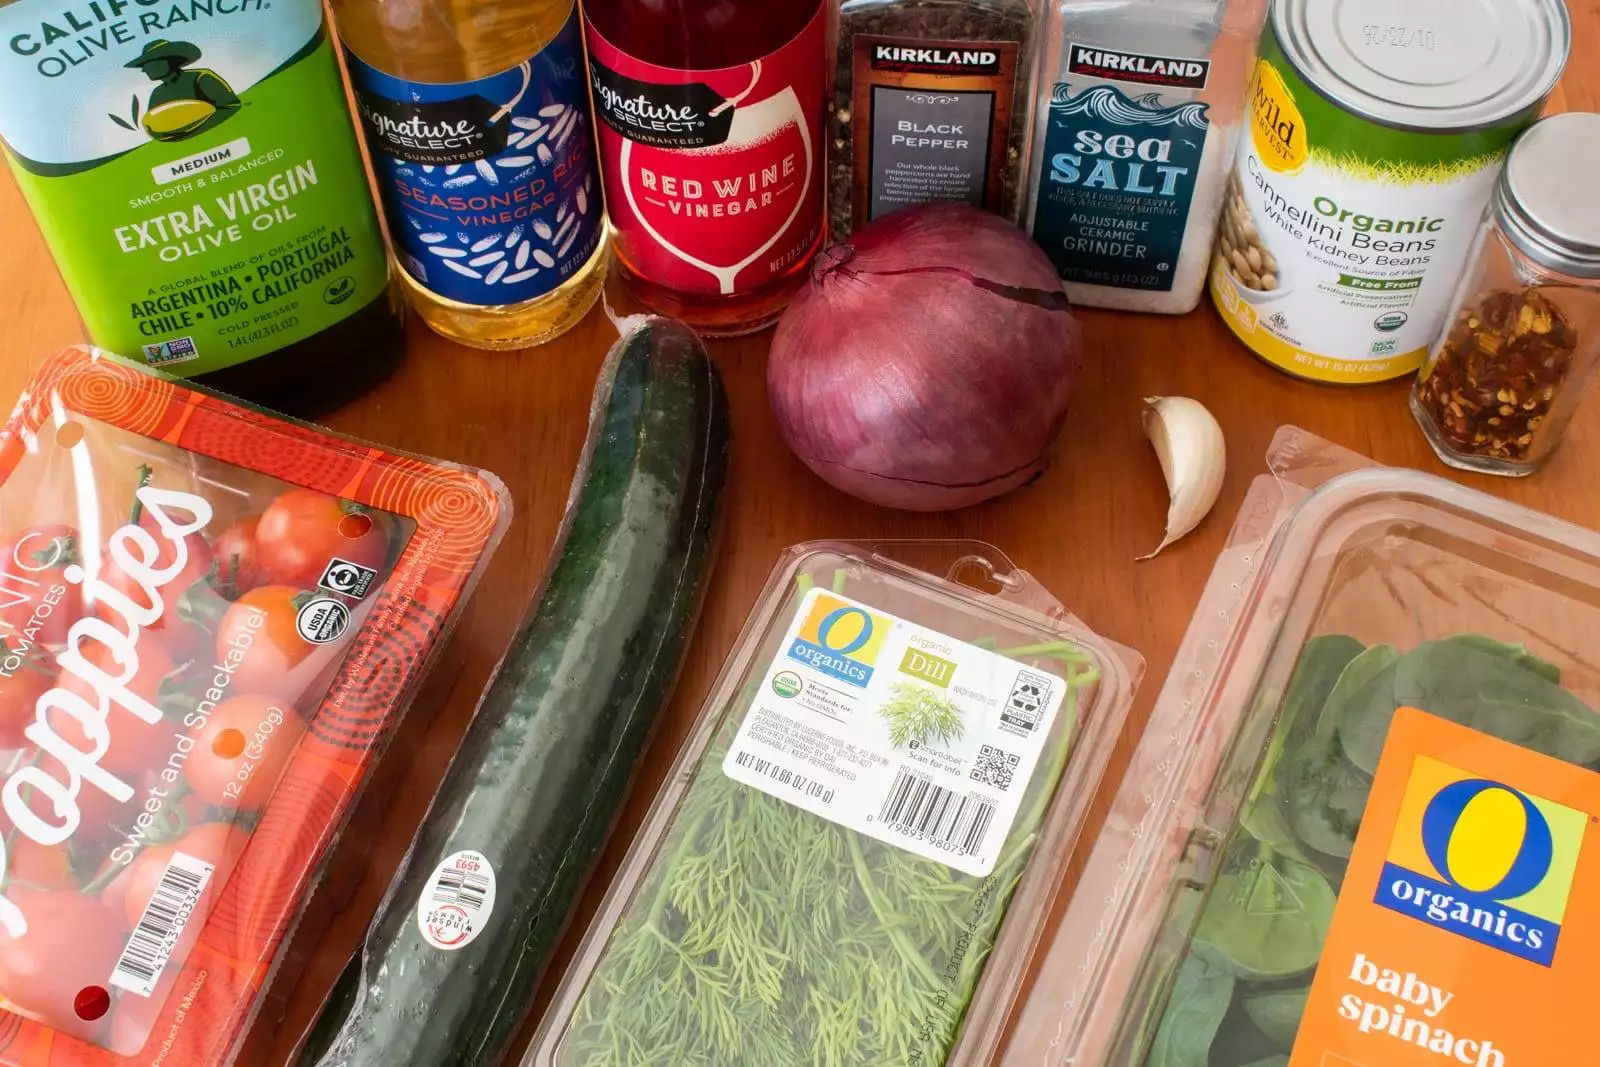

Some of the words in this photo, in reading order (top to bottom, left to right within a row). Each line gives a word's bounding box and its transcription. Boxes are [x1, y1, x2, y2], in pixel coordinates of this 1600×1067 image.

[10, 0, 159, 56] CALIF
[37, 21, 136, 77] OLIVE
[138, 0, 263, 35] RANCH
[876, 46, 997, 65] KIRKLAND
[1077, 48, 1203, 78] KIRKLAND
[590, 62, 698, 120] Signature
[613, 107, 697, 132] SELECT
[897, 120, 964, 135] BLACK
[1256, 77, 1295, 149] wild
[387, 132, 474, 150] SELECT
[627, 130, 704, 145] GUARANTEED
[891, 134, 969, 149] PEPPER
[1074, 129, 1172, 163] sea
[171, 148, 232, 177] MEDIUM
[404, 149, 484, 163] GUARANTEED
[885, 168, 935, 177] peppercorns
[912, 163, 937, 171] whole
[129, 182, 193, 210] SMOOTH
[197, 178, 207, 189] &
[211, 148, 284, 184] BALANCED
[641, 167, 703, 199] RED
[712, 153, 795, 198] WINE
[1050, 152, 1188, 196] SALT
[113, 203, 215, 253] EXTRA
[215, 159, 318, 221] VIRGIN
[394, 178, 546, 212] SEASONED
[457, 193, 556, 226] VINEGAR
[668, 191, 772, 217] VINEGAR
[1247, 155, 1343, 242] Cannellini
[1351, 231, 1437, 253] Beans
[1069, 213, 1150, 232] ADJUSTABLE
[1312, 195, 1445, 234] Organic
[159, 224, 242, 262] OLIVE
[252, 205, 297, 231] OIL
[1063, 236, 1147, 259] GRINDER
[1079, 226, 1135, 242] CERAMIC
[1263, 200, 1304, 240] White
[1307, 235, 1370, 266] Kidney
[1374, 254, 1431, 267] Beans
[130, 275, 243, 319] ARGENTINA
[256, 226, 352, 282] PORTUGAL
[148, 288, 156, 296] A
[160, 273, 207, 293] GLOBAL
[210, 260, 245, 277] BLEND
[250, 253, 265, 265] OF
[268, 241, 293, 257] OILS
[296, 225, 326, 243] FROM
[1306, 250, 1349, 271] Excellent
[1352, 266, 1387, 277] Source
[1388, 269, 1399, 277] of
[1399, 267, 1427, 276] Fiber
[139, 312, 195, 337] CHILE
[206, 295, 248, 320] 10%
[251, 245, 355, 306] CALIFORNIA
[1317, 283, 1354, 298] Artificial
[1355, 292, 1413, 301] Preservatives
[1351, 278, 1382, 289] Free
[1385, 279, 1419, 289] From
[217, 320, 250, 336] COLD
[254, 301, 299, 325] PRESSED
[1340, 299, 1378, 308] Artificial
[1294, 352, 1313, 365] NET
[1314, 359, 1330, 370] WT
[0, 583, 66, 678] TOMATOES
[307, 608, 328, 632] USDA
[319, 607, 341, 638] ORGANIC
[373, 605, 393, 636] Family
[818, 607, 873, 655] O
[910, 634, 954, 655] organic
[795, 645, 867, 680] organics
[908, 652, 949, 681] Dill
[806, 690, 839, 707] Standards
[809, 683, 828, 695] Meets
[0, 487, 213, 939] oppies
[758, 707, 793, 727] DISTRIBUTED
[1006, 708, 1034, 723] PLASTIC
[1008, 716, 1025, 727] TRAY
[110, 786, 168, 865] Sweet
[161, 733, 195, 784] and
[183, 606, 269, 730] Snackable!
[244, 706, 284, 761] (340g)
[751, 722, 783, 741] CERTIFIED
[784, 736, 813, 752] ORGANIC
[814, 748, 823, 758] BY
[237, 763, 257, 781] oz
[747, 730, 787, 752] PERISHABLE
[791, 748, 809, 760] KEEP
[808, 756, 857, 781] REFRIGERATED
[908, 751, 928, 763] Scan
[930, 759, 942, 769] for
[944, 765, 961, 776] info
[223, 781, 243, 800] 12
[735, 750, 755, 768] NET
[754, 758, 772, 775] WT
[770, 765, 793, 785] 0.66
[792, 774, 807, 790] OZ
[805, 780, 824, 798] (19
[822, 788, 835, 804] g)
[867, 813, 873, 822] 0
[888, 821, 924, 841] 79893
[929, 836, 965, 856] 98075
[1421, 778, 1553, 901] O
[456, 859, 480, 872] 4593
[155, 931, 179, 972] 41243
[174, 888, 201, 926] 00334
[1391, 879, 1544, 949] organics
[944, 922, 977, 983] PRODUCT
[1348, 952, 1454, 1018] baby
[152, 1024, 179, 1067] Product
[177, 1008, 187, 1024] of
[183, 969, 208, 1010] Mexico
[1338, 992, 1506, 1067] spinach
